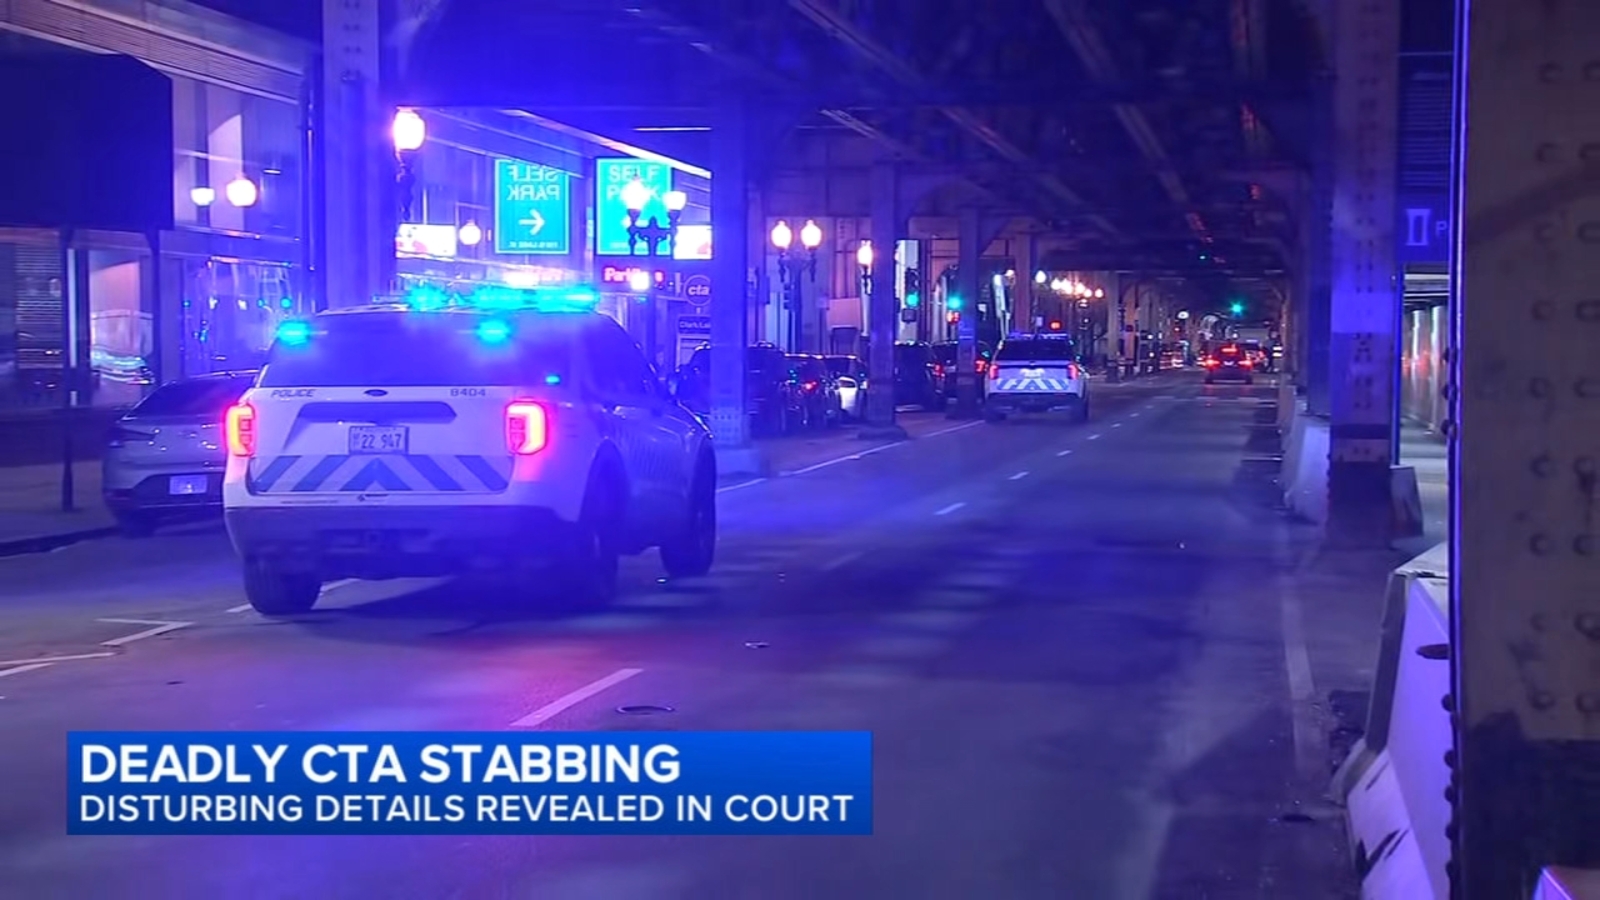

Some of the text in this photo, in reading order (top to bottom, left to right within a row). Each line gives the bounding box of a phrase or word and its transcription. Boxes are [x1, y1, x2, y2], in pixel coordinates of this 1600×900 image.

[609, 164, 660, 182] SELF
[606, 184, 661, 201] PK
[688, 285, 710, 296] cta
[270, 388, 317, 398] POLICE
[450, 388, 487, 397] 8404
